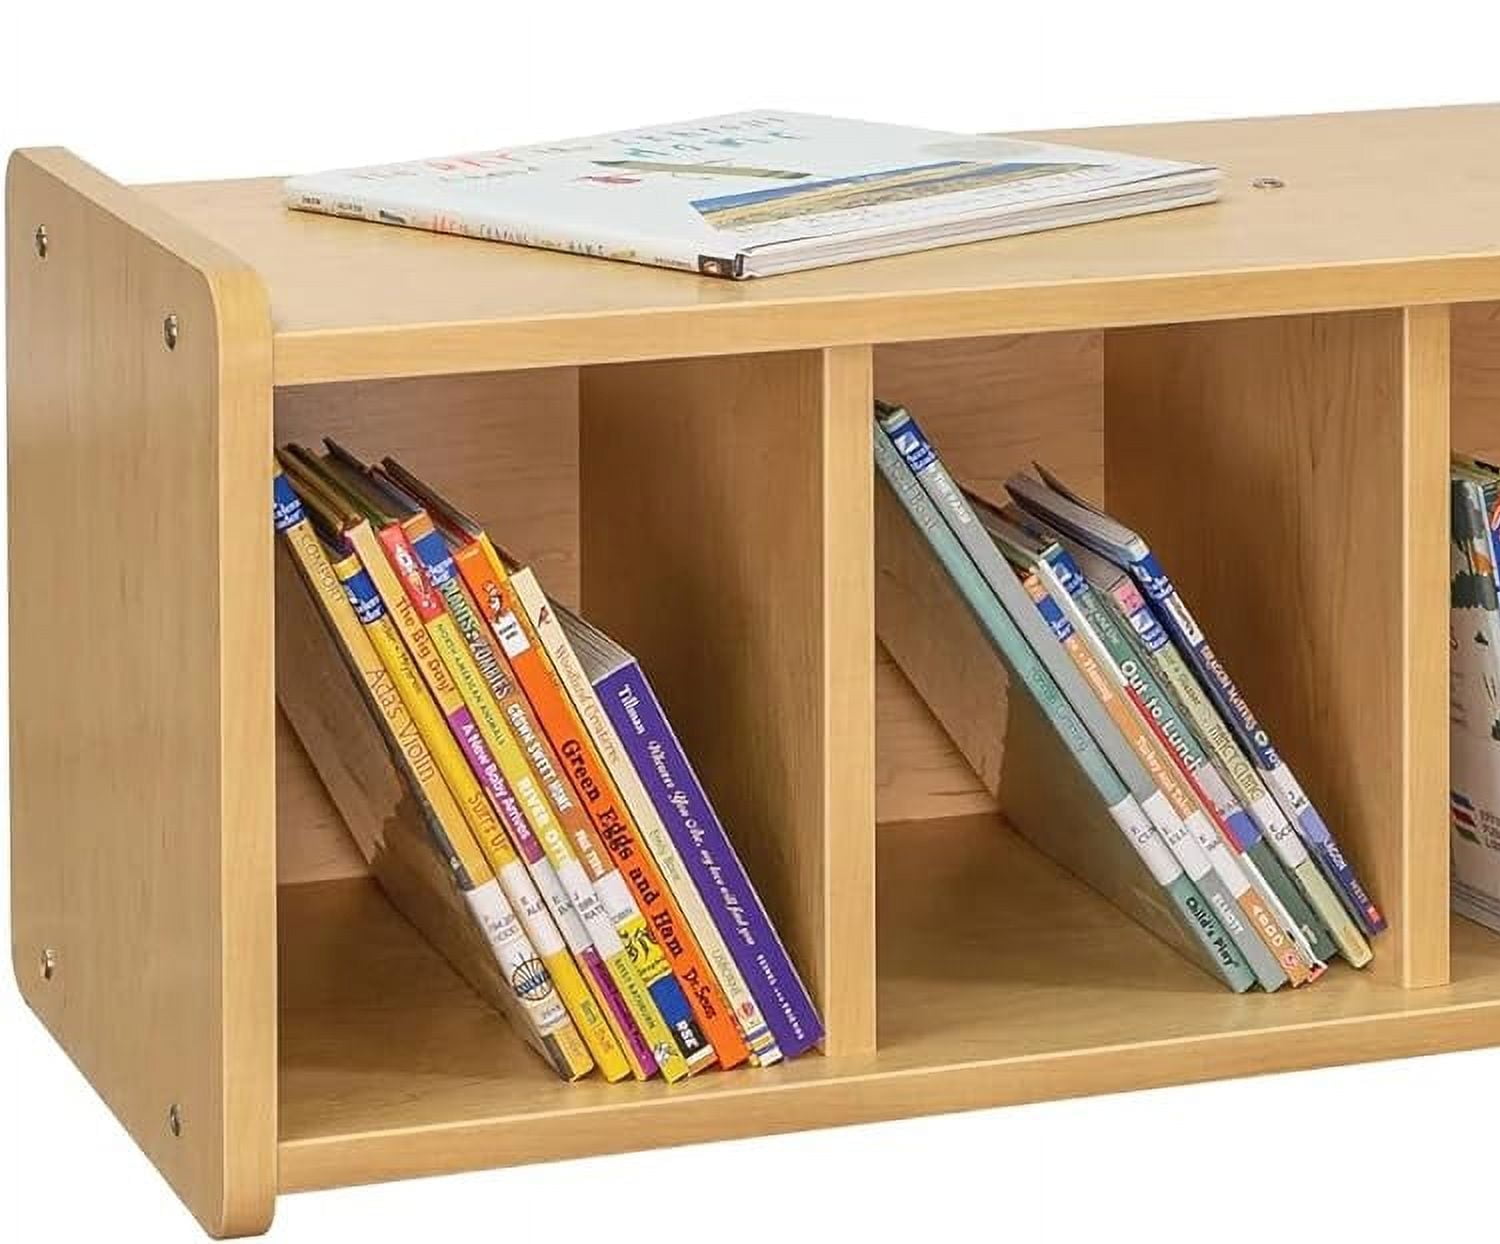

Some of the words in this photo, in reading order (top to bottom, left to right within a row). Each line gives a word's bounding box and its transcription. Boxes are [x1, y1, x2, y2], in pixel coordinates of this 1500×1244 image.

[394, 595, 418, 627] The
[409, 626, 433, 658] Big
[468, 636, 514, 700] ZOMBIES
[462, 723, 475, 734] A
[615, 682, 652, 735] Tillman
[1119, 659, 1144, 688] Out
[1147, 702, 1165, 721] to
[1160, 717, 1203, 774] Lunch
[394, 720, 438, 782] Violin
[468, 733, 490, 764] New
[483, 764, 507, 797] Baby
[500, 794, 530, 840] Arrives
[560, 738, 604, 802] Green
[594, 806, 638, 862] Eggs
[628, 864, 661, 905] and
[651, 909, 687, 958] Ham
[694, 984, 721, 1019] Seuss
[1186, 897, 1217, 937] Child's
[1213, 937, 1240, 967] Play
